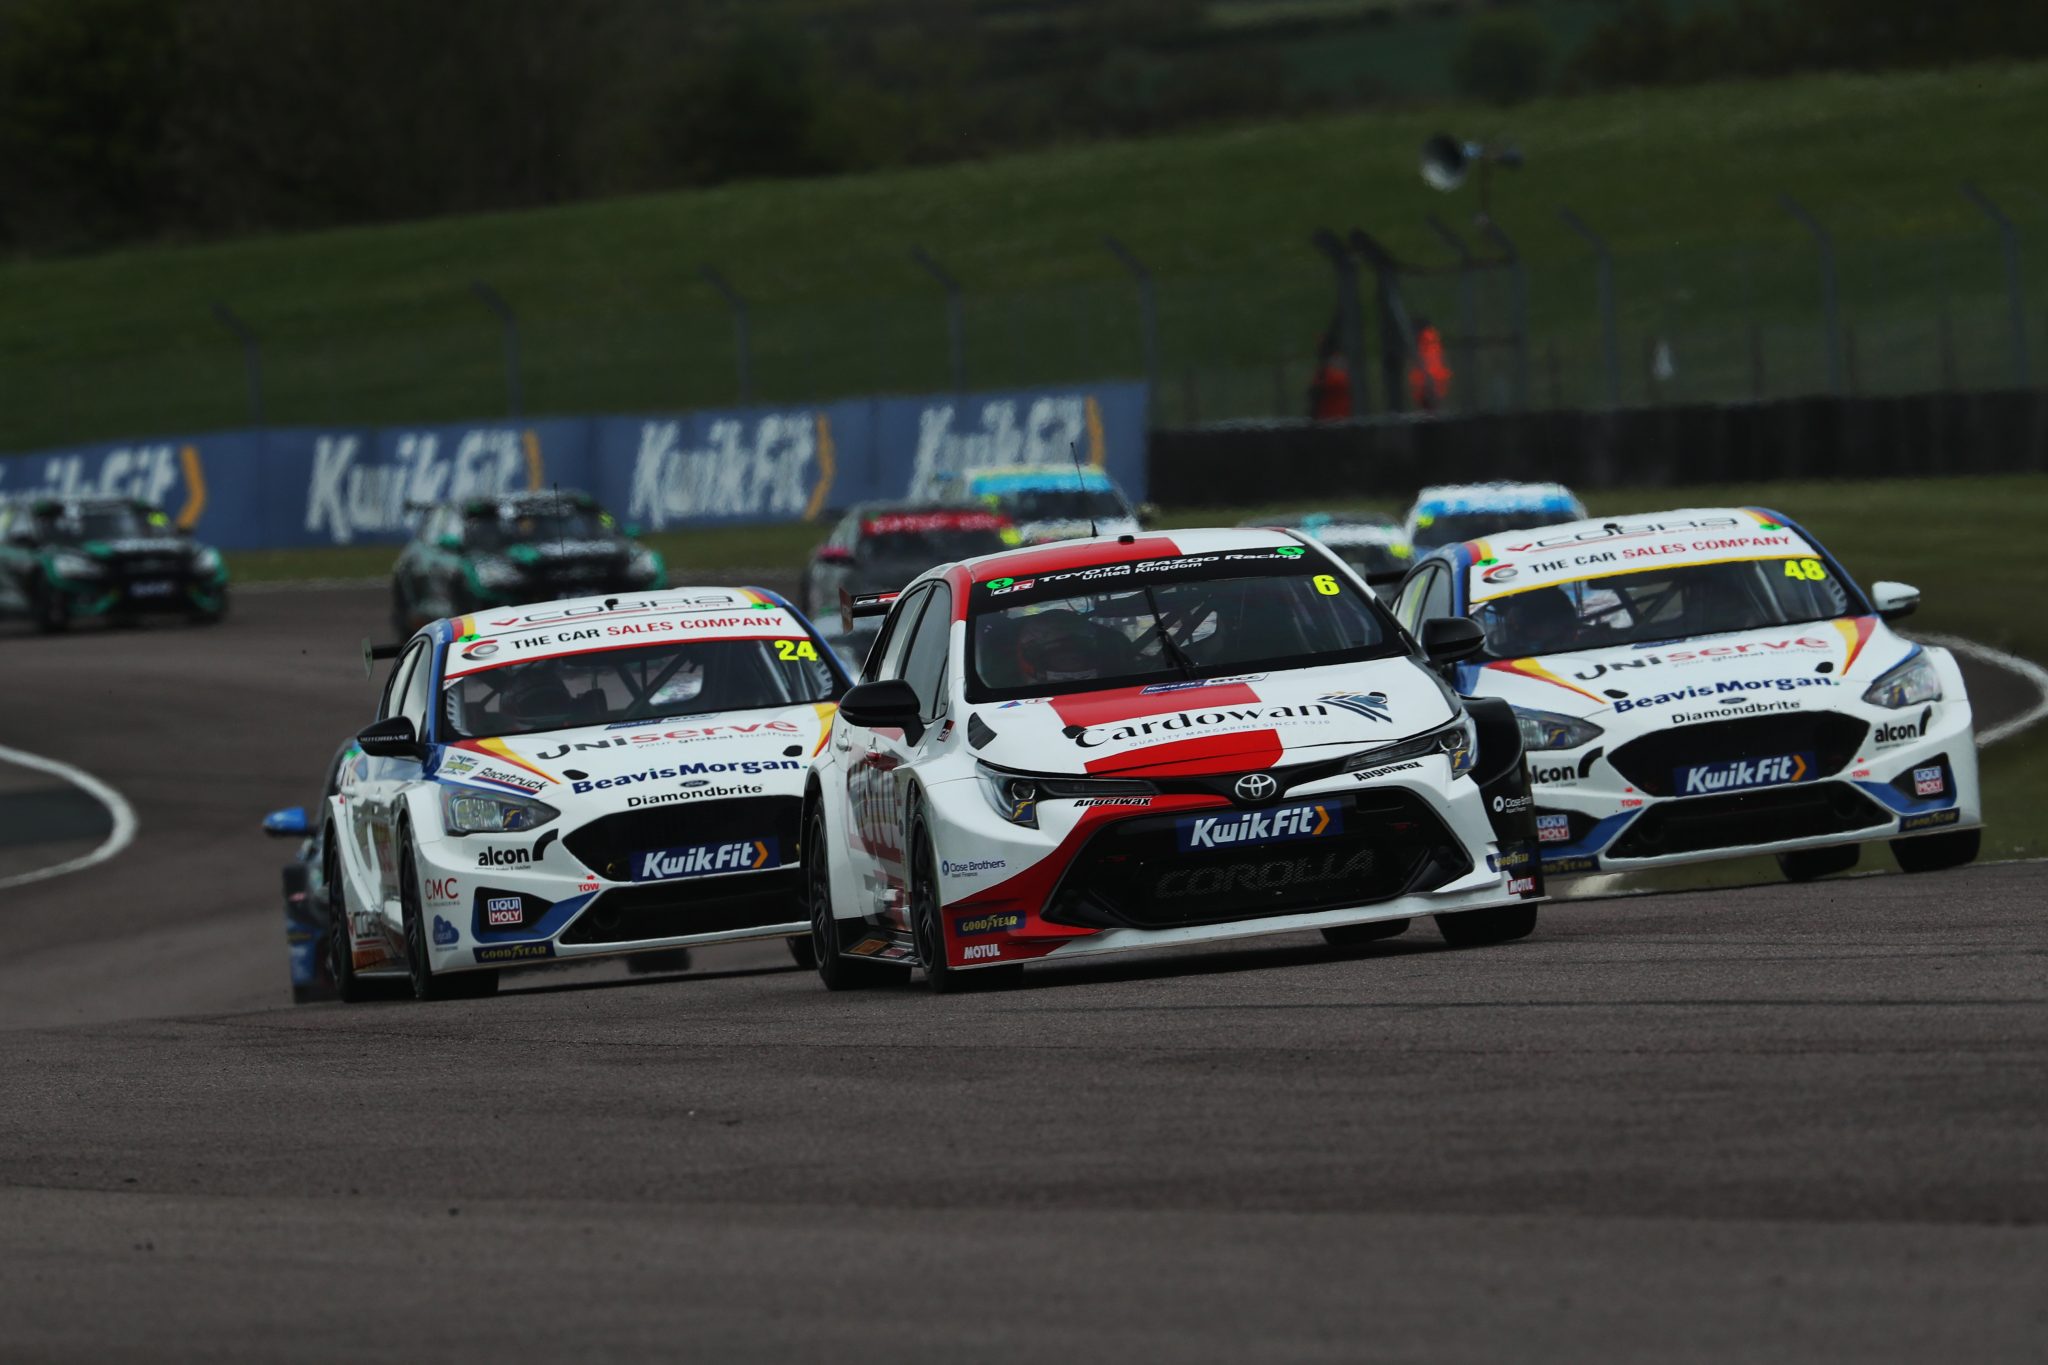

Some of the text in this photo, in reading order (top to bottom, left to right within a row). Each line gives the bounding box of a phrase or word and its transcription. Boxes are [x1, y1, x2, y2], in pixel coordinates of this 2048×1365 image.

[1529, 535, 1791, 574] THE CAR SALES COMPANY
[1039, 564, 1130, 583] TOYOTA
[1137, 555, 1219, 569] GAZOO
[1225, 552, 1302, 562] Racing
[1082, 562, 1203, 581] United Kingdom
[1784, 559, 1828, 582] 48
[1312, 574, 1341, 596] 6
[510, 616, 784, 650] THE CAR SALES COMPANY
[774, 640, 818, 662] 24
[1672, 700, 1800, 724] Diamondbrite
[1075, 703, 1328, 748] Cardowan
[1875, 723, 1918, 742] alcon
[479, 767, 549, 790] Racetruck
[1529, 765, 1575, 784] lcon
[627, 784, 763, 807] Diamondbrite
[1621, 799, 1643, 808] TOW
[478, 846, 530, 866] alcon
[950, 860, 1006, 873] Close Brothers
[1154, 848, 1376, 899] COROLLA
[425, 877, 459, 900] CMC
[578, 883, 600, 893] TOW
[490, 900, 520, 911] LIQUI
[491, 911, 521, 923] MOLY
[962, 914, 1018, 932] GOODYEAR
[480, 944, 547, 960] GOODYEAR
[963, 943, 1001, 960] MOTUL
